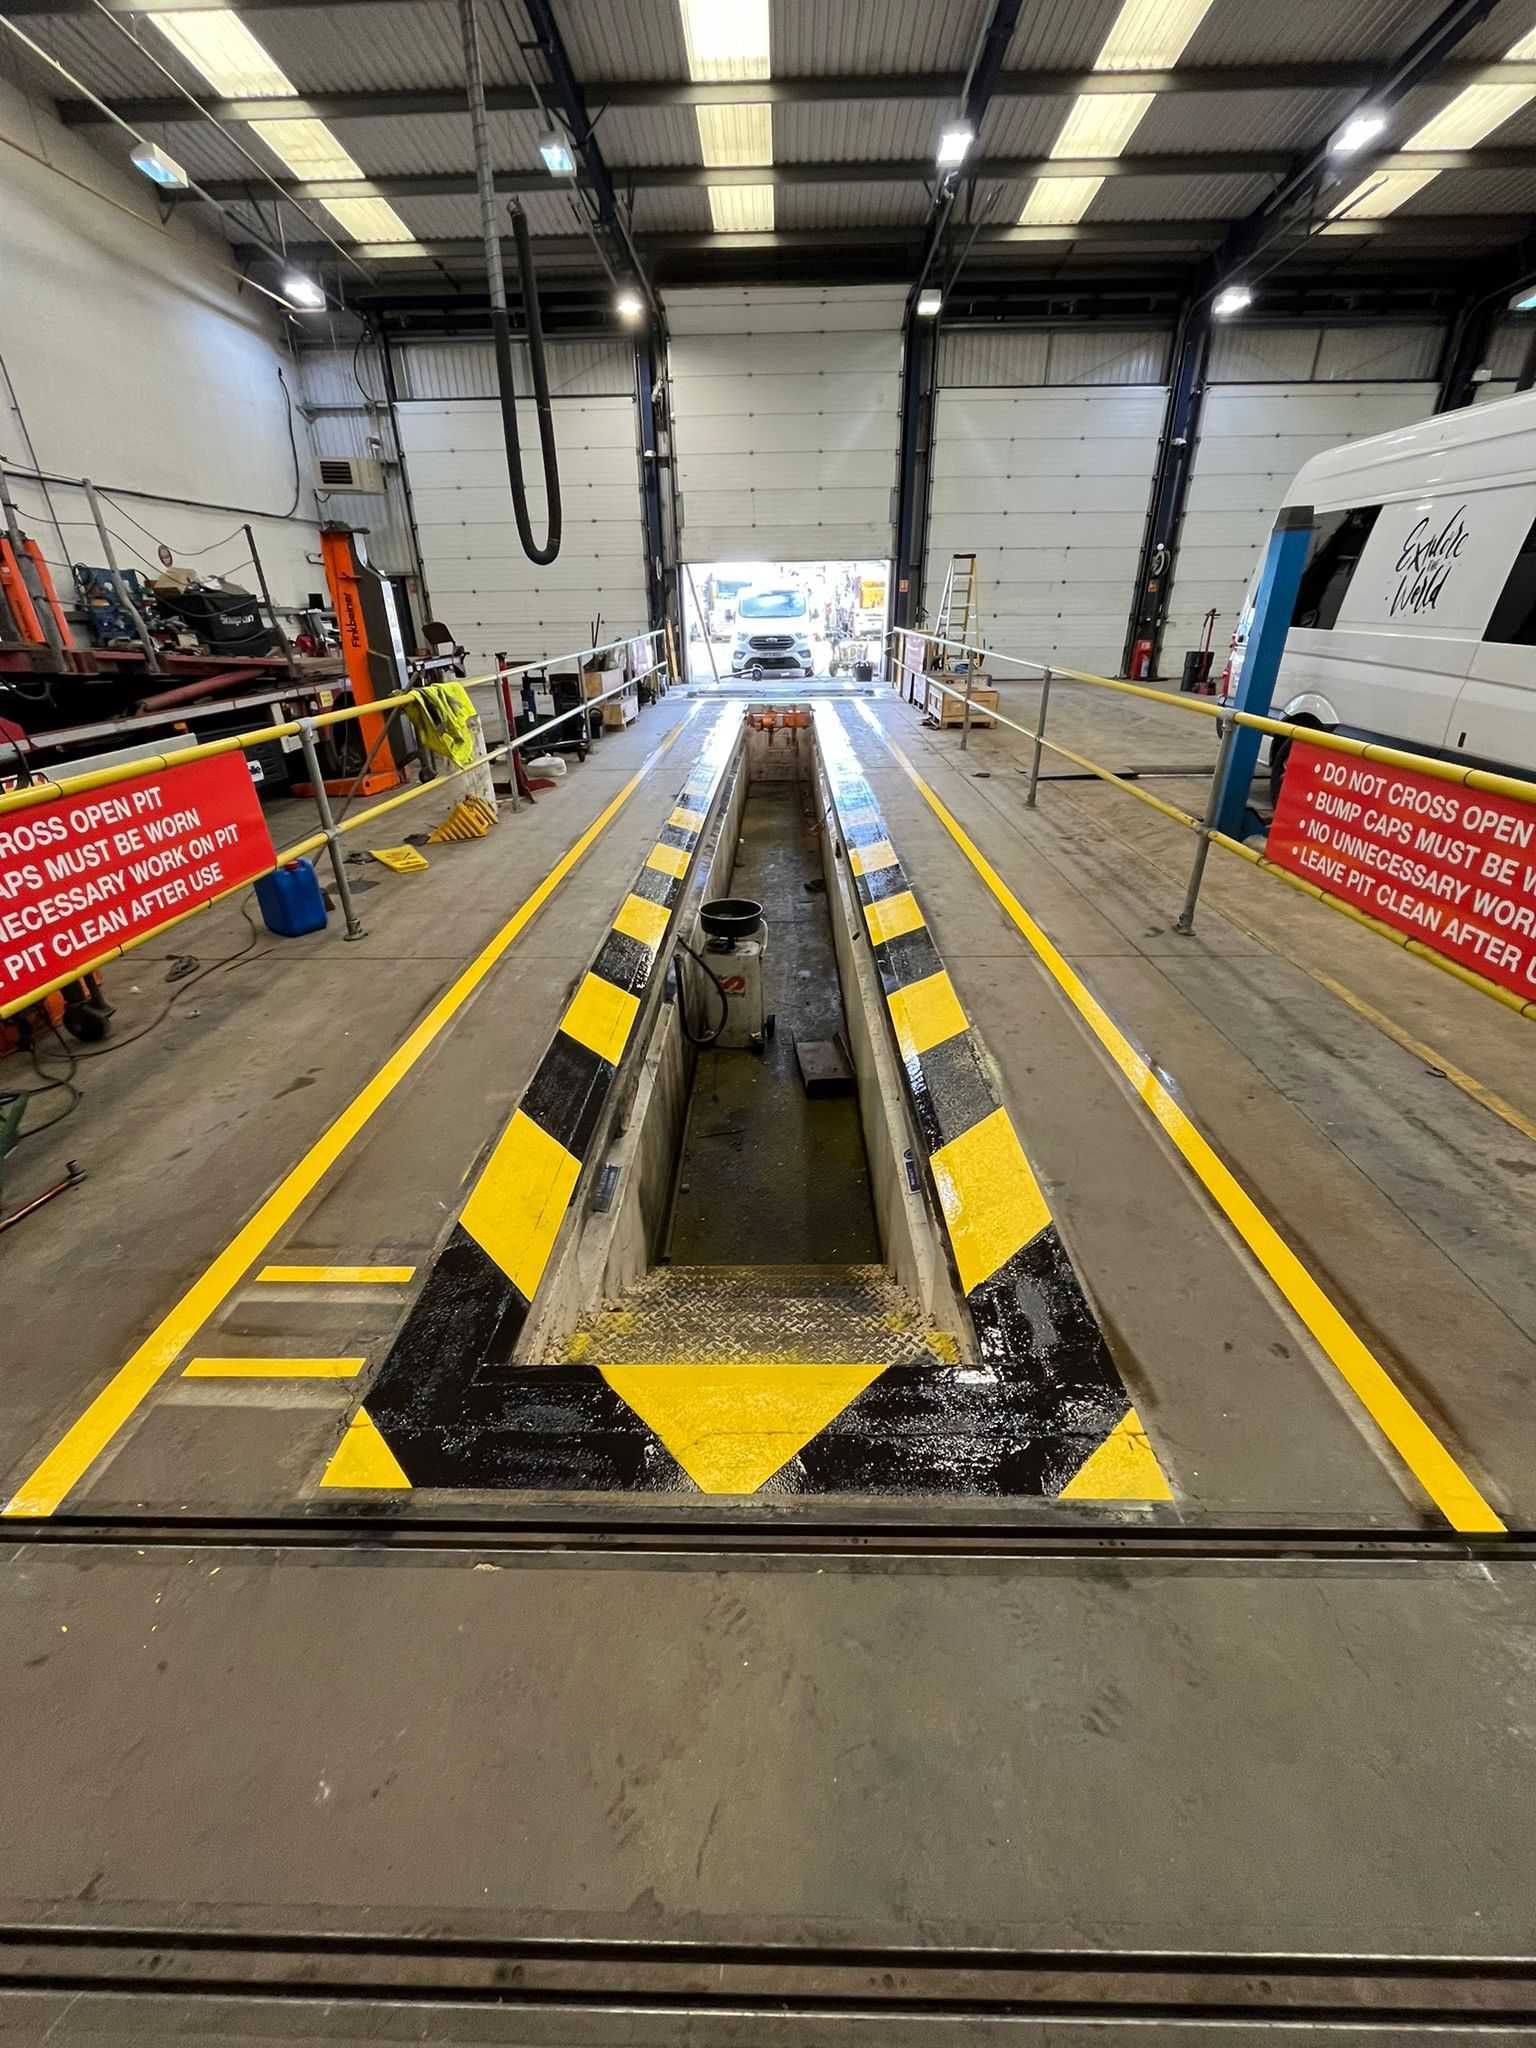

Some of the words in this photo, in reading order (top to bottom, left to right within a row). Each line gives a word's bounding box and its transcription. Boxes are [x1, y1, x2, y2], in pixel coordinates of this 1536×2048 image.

[1395, 504, 1469, 572] Explore
[219, 614, 255, 627] Snapon
[1389, 565, 1452, 617] World
[70, 797, 132, 833] OPEN
[132, 786, 162, 814] PIT
[1315, 791, 1362, 823] BUMP
[1363, 809, 1413, 844] CAPS
[1414, 828, 1481, 869] MUST
[1480, 852, 1520, 886] BE
[1323, 762, 1347, 786] DO
[1348, 770, 1387, 799] NOT
[1388, 783, 1460, 823] CROSS
[1462, 806, 1535, 848] OPEN
[44, 839, 110, 882] MUST
[113, 828, 145, 856] BE
[142, 808, 201, 844] WORN
[128, 845, 189, 885] WORK
[188, 834, 215, 859] ON
[214, 824, 239, 849] PIT
[1307, 819, 1330, 843] NO
[1332, 829, 1472, 905] UNNECESSARY
[1472, 889, 1536, 939] WOR
[4, 942, 47, 981] PIT
[52, 906, 129, 957] CLEAN
[131, 878, 190, 922] AFTER
[188, 862, 224, 891] USE
[1300, 846, 1346, 883] LEAVE
[1346, 869, 1376, 897] PIT
[1377, 884, 1443, 932] CLEAN
[1441, 918, 1523, 973] AFTER
